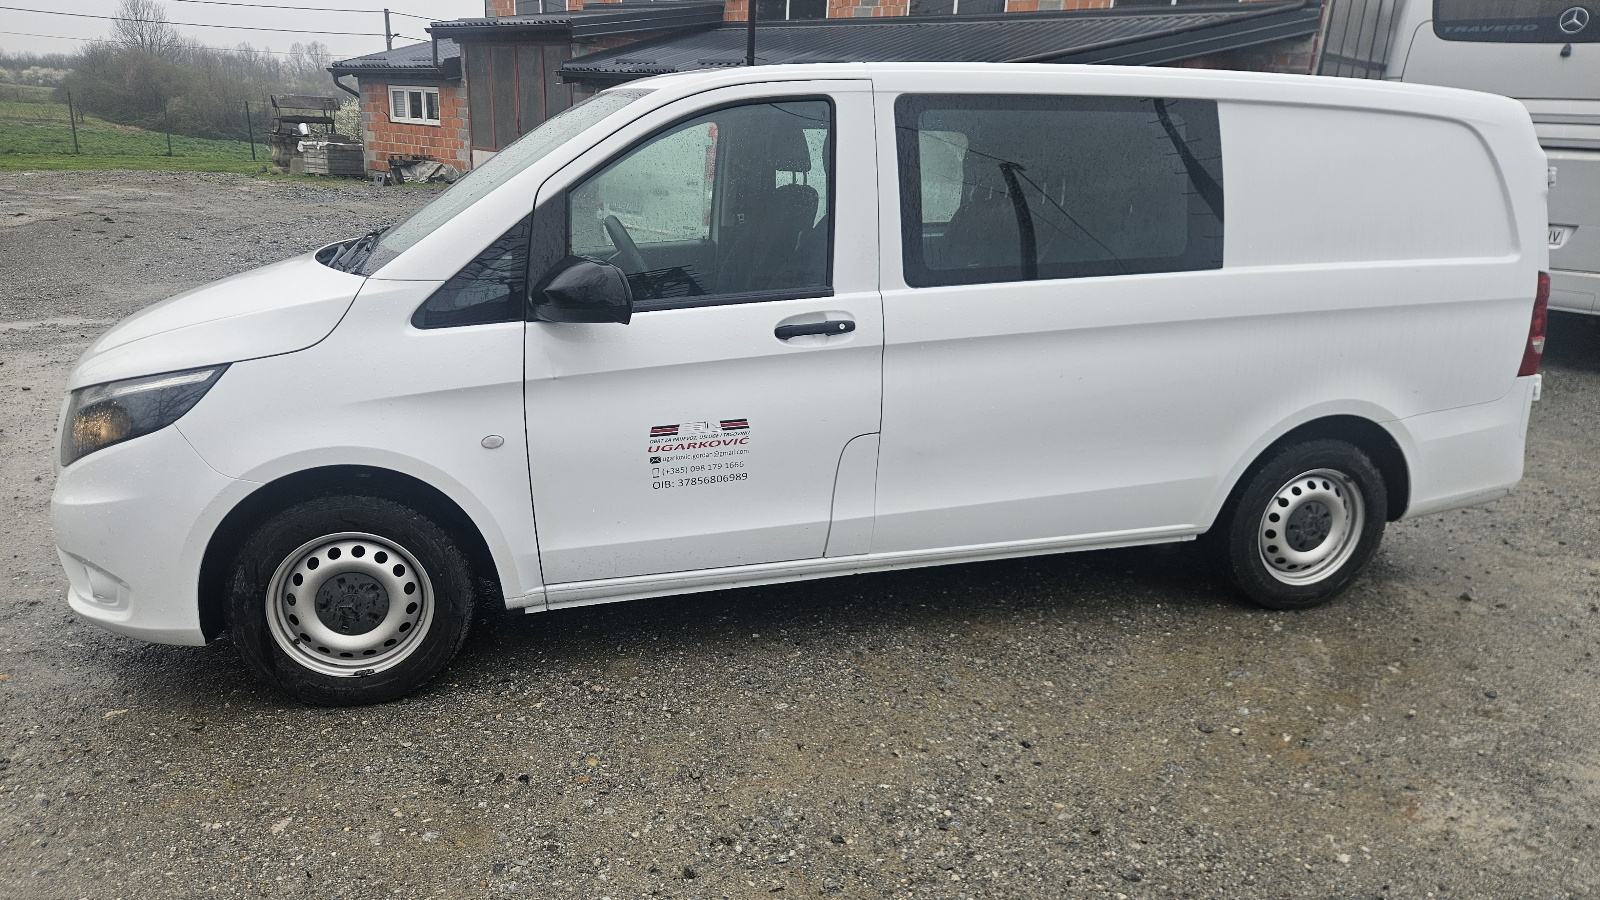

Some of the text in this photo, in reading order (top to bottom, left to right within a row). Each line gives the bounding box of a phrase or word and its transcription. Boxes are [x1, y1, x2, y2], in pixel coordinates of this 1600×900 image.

[647, 436, 750, 453] UGARKOVIĆ
[662, 466, 688, 476] (+385)
[708, 463, 723, 471] 179
[652, 472, 748, 490] OIB: 37856806989
